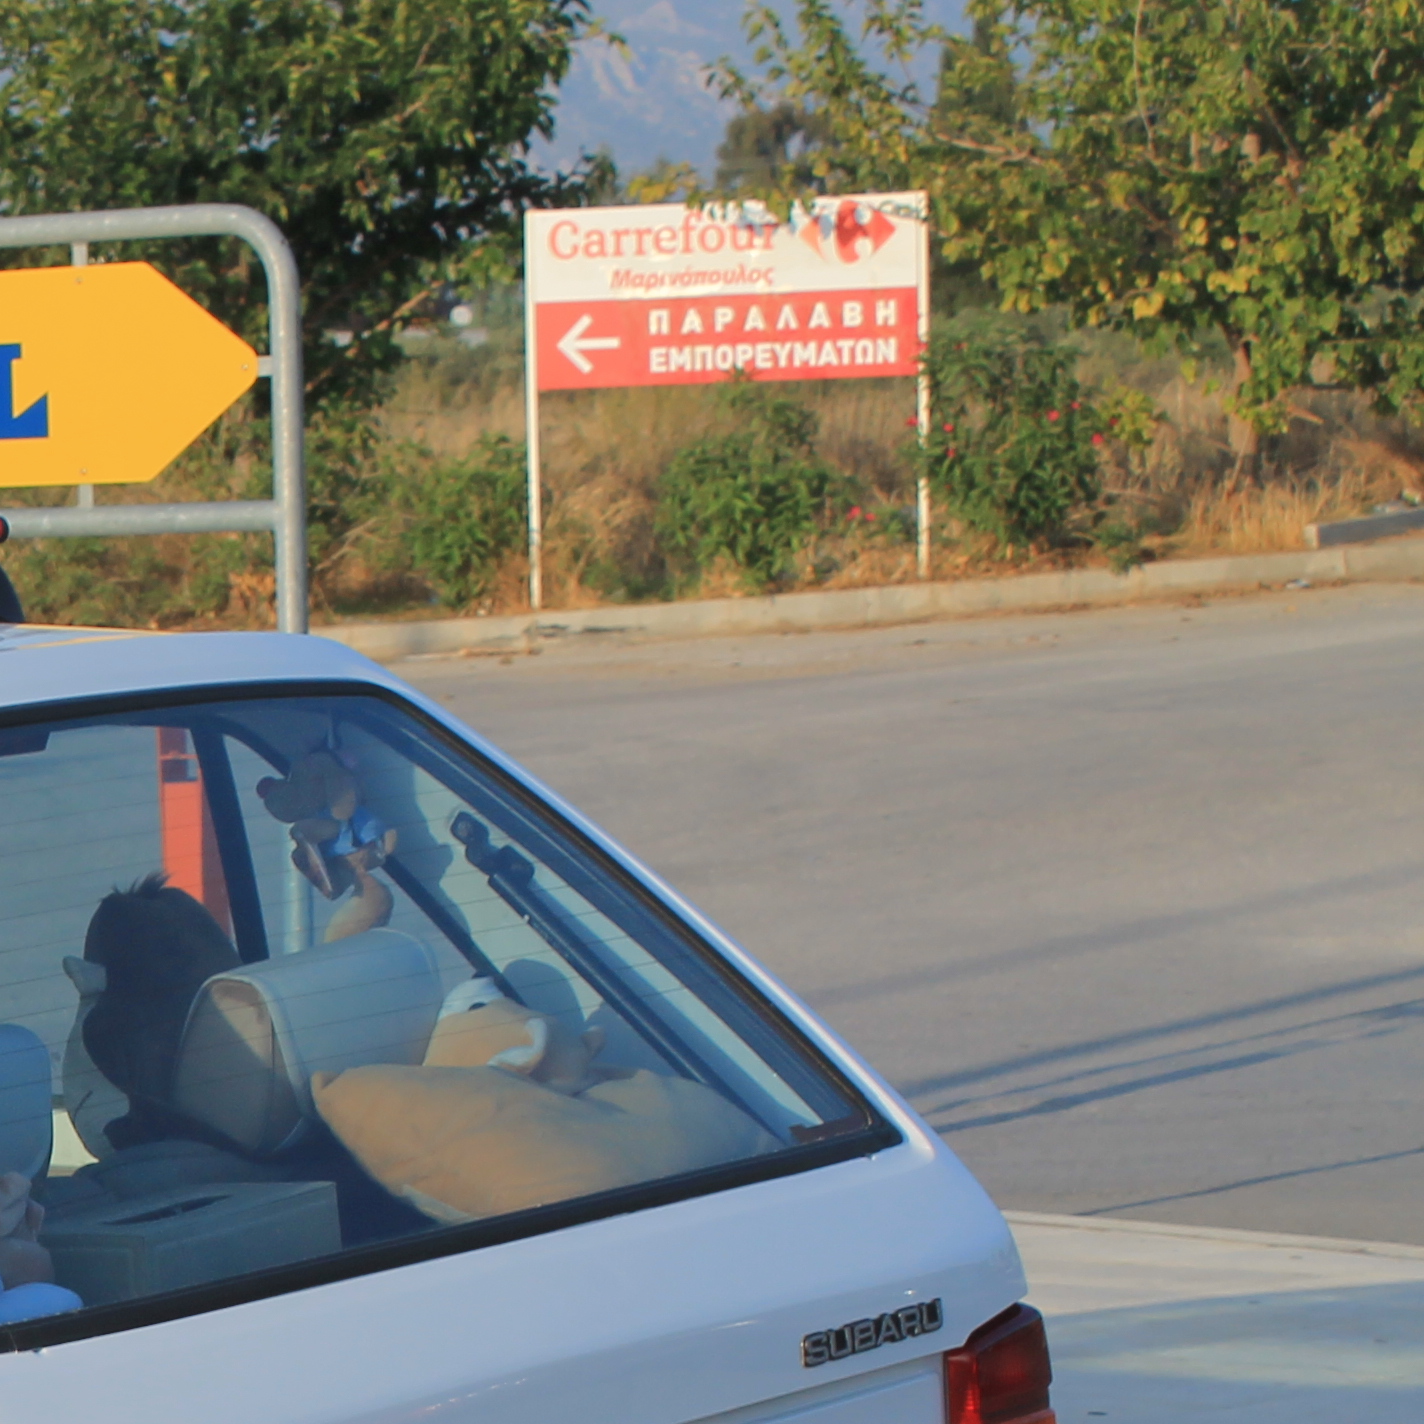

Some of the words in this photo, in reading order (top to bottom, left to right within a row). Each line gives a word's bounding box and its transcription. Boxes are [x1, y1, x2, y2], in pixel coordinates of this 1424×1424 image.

[548, 211, 775, 260] Carrefour
[648, 299, 897, 335] ΠΑΡΑΛΑΒΗ
[649, 337, 897, 373] ΕΜΠΟΡΕΥΜΑΤΩΝ
[802, 1298, 943, 1367] SUBARU
